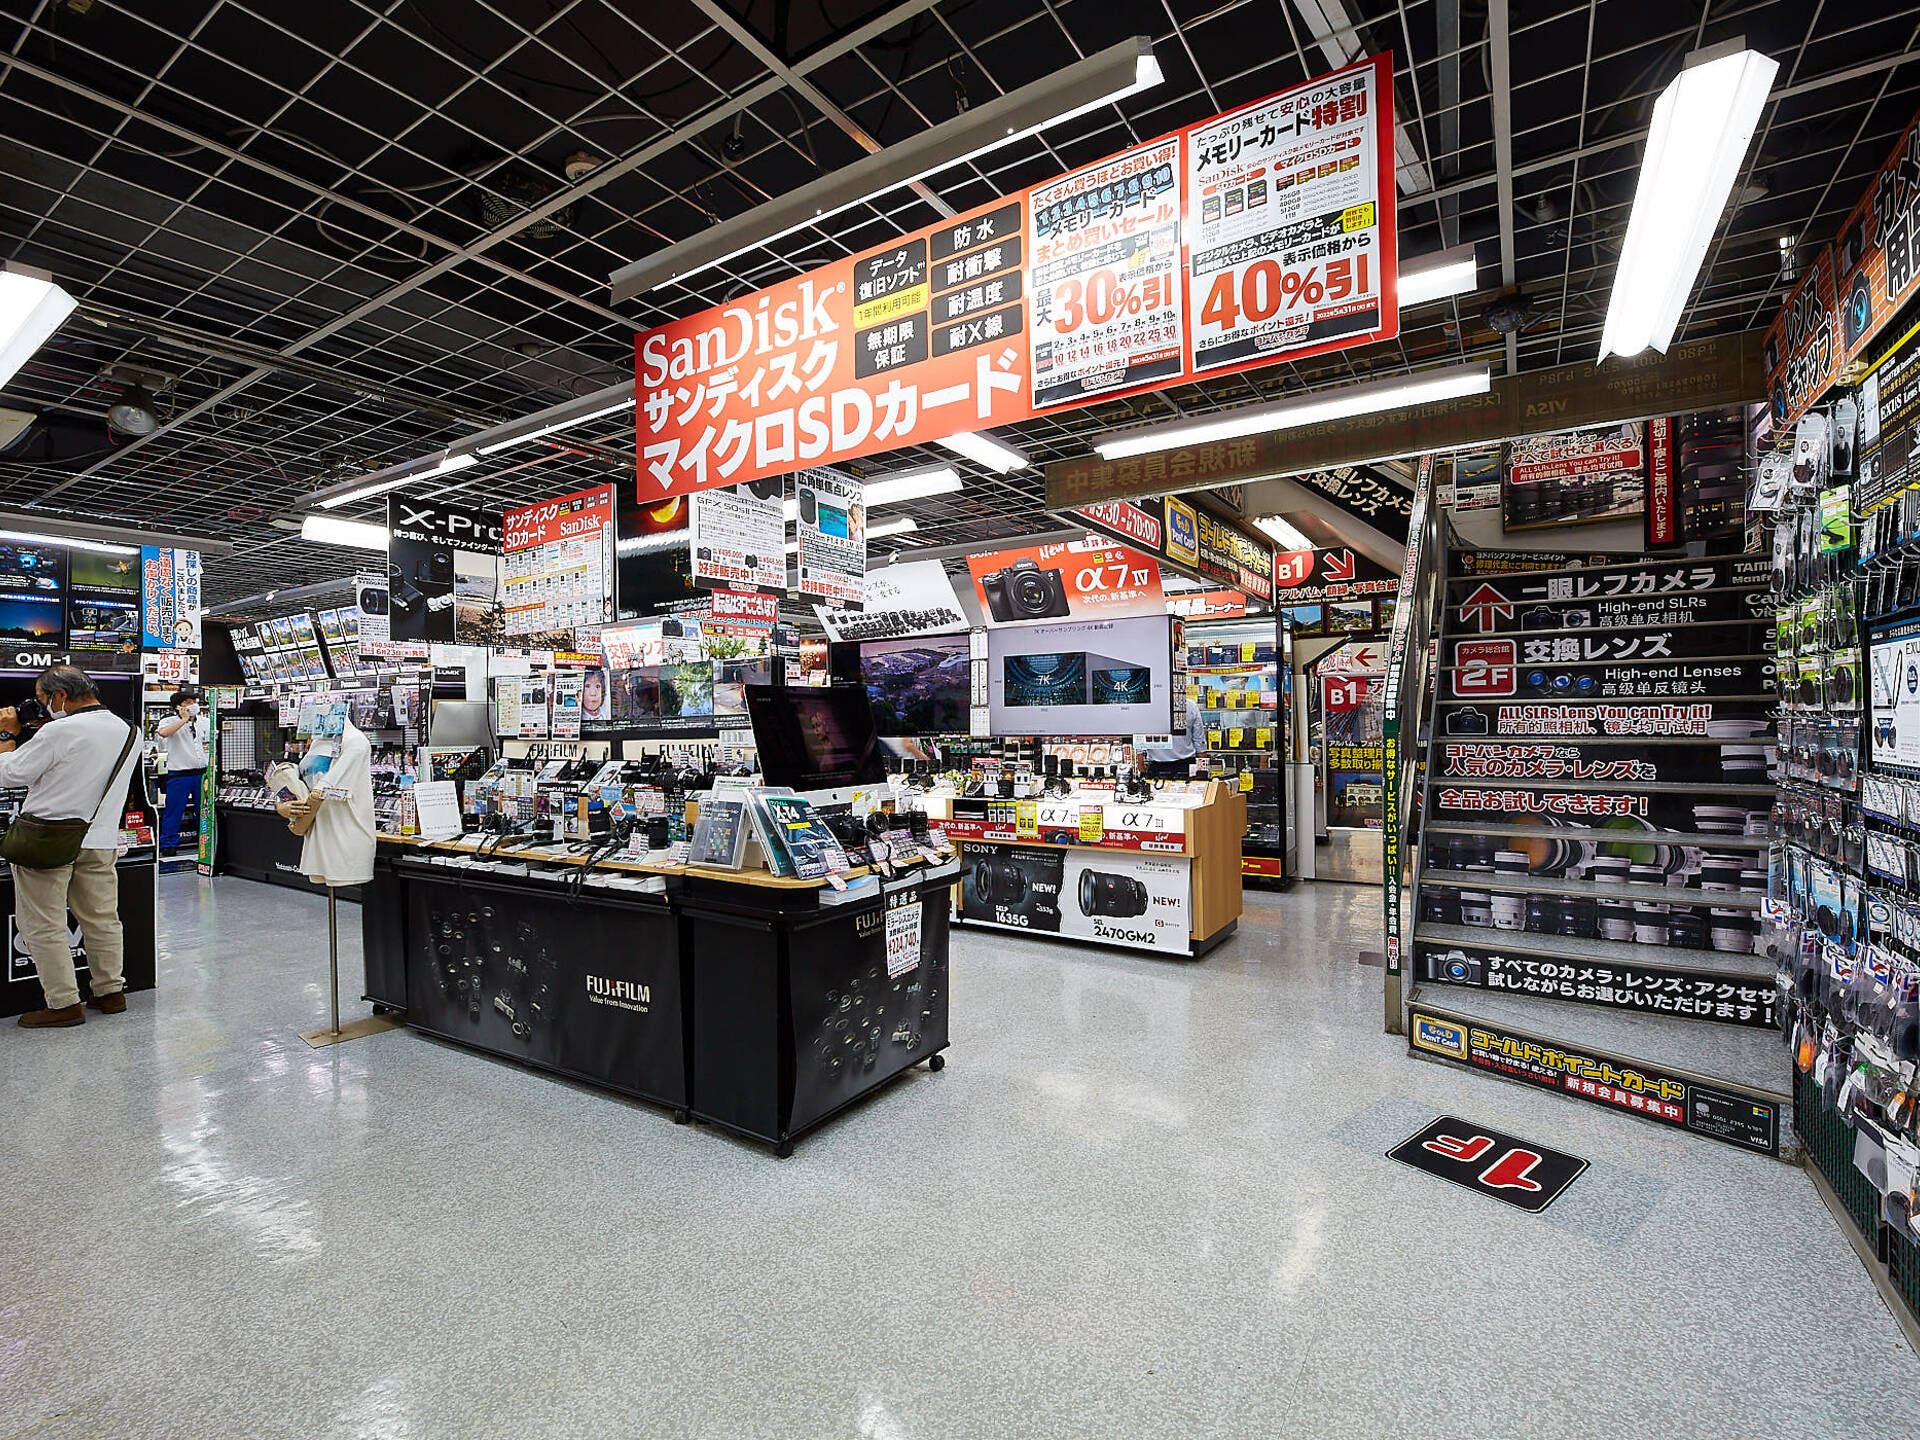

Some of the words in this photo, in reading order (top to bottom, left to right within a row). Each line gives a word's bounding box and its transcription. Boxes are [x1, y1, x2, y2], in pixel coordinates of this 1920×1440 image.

[1197, 90, 1367, 172] メモリーカード特割
[1874, 129, 1920, 248] カメ
[1051, 189, 1156, 239] メモリーカード
[1037, 203, 1173, 264] まとめ買いセール
[1283, 233, 1370, 267] 表示価格から
[869, 251, 908, 277] データ
[947, 248, 1001, 285] 耐衝撃
[948, 281, 1003, 317] 耐温度
[867, 321, 914, 351] 無期限
[875, 345, 906, 369] 保証
[643, 340, 839, 434] サンディスク
[644, 348, 1022, 491] マイクロSDカード
[1312, 472, 1382, 516] 交換レンズ
[506, 503, 558, 530] サンディスク
[560, 513, 602, 536] SanDisk
[506, 527, 546, 549] SDカード
[1279, 555, 1303, 580] B1
[1522, 567, 1716, 601] 一眼レフカメラ
[1598, 599, 1665, 615] High-end
[1669, 597, 1707, 609] SLRs
[1599, 611, 1695, 628] 高级单反相机
[15, 652, 71, 667] OM-1
[1523, 632, 1673, 663] 交換レンズ
[1038, 675, 1051, 685] 7K
[1461, 659, 1509, 687] 2F
[1604, 667, 1679, 681] High-end
[1683, 665, 1742, 678] Lenses
[1113, 681, 1129, 692] 4K
[1331, 682, 1357, 705] B1
[1602, 681, 1707, 696] 高级单反镜头
[1498, 706, 1525, 720] ALL
[1597, 705, 1630, 720] You
[1632, 707, 1659, 720] can
[1661, 705, 1690, 722] Try
[1692, 703, 1712, 720] it!
[1444, 759, 1657, 781] 人気のカメラ・レンズを
[1439, 788, 1649, 816] 全品お試しできます！
[963, 844, 998, 854] SONY
[1032, 882, 1056, 894] NEW!
[1153, 896, 1181, 908] NEW!
[995, 912, 1029, 926] 1635G
[1094, 926, 1156, 944] 2470GM2
[586, 975, 650, 1003] FUJIFILM
[1488, 973, 1773, 1023] 試しながらお選びいただけます！
[1470, 1029, 1685, 1100] ゴールドポイントカード
[1567, 1077, 1679, 1118] 新規会員募集中
[1750, 1136, 1769, 1146] VISA
